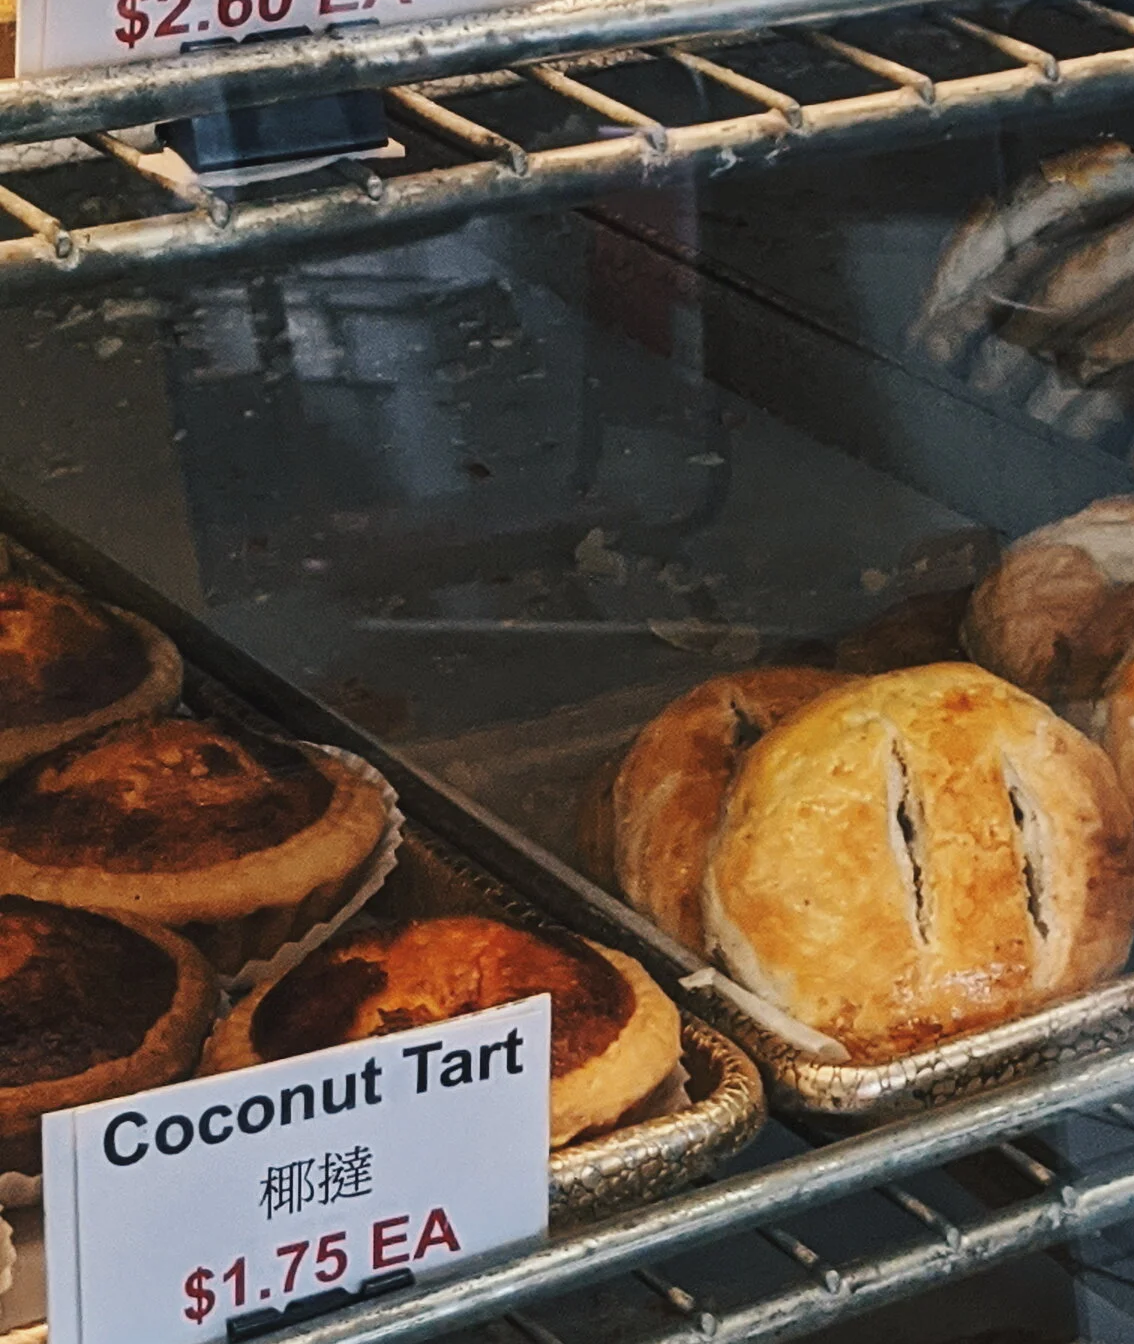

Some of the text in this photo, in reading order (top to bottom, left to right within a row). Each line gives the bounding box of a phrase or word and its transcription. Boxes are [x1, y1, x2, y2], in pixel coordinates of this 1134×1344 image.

[103, 1027, 524, 1167] Coconut Tart
[259, 1145, 372, 1220] 椰撻
[184, 1207, 462, 1325] $1.75 EA
